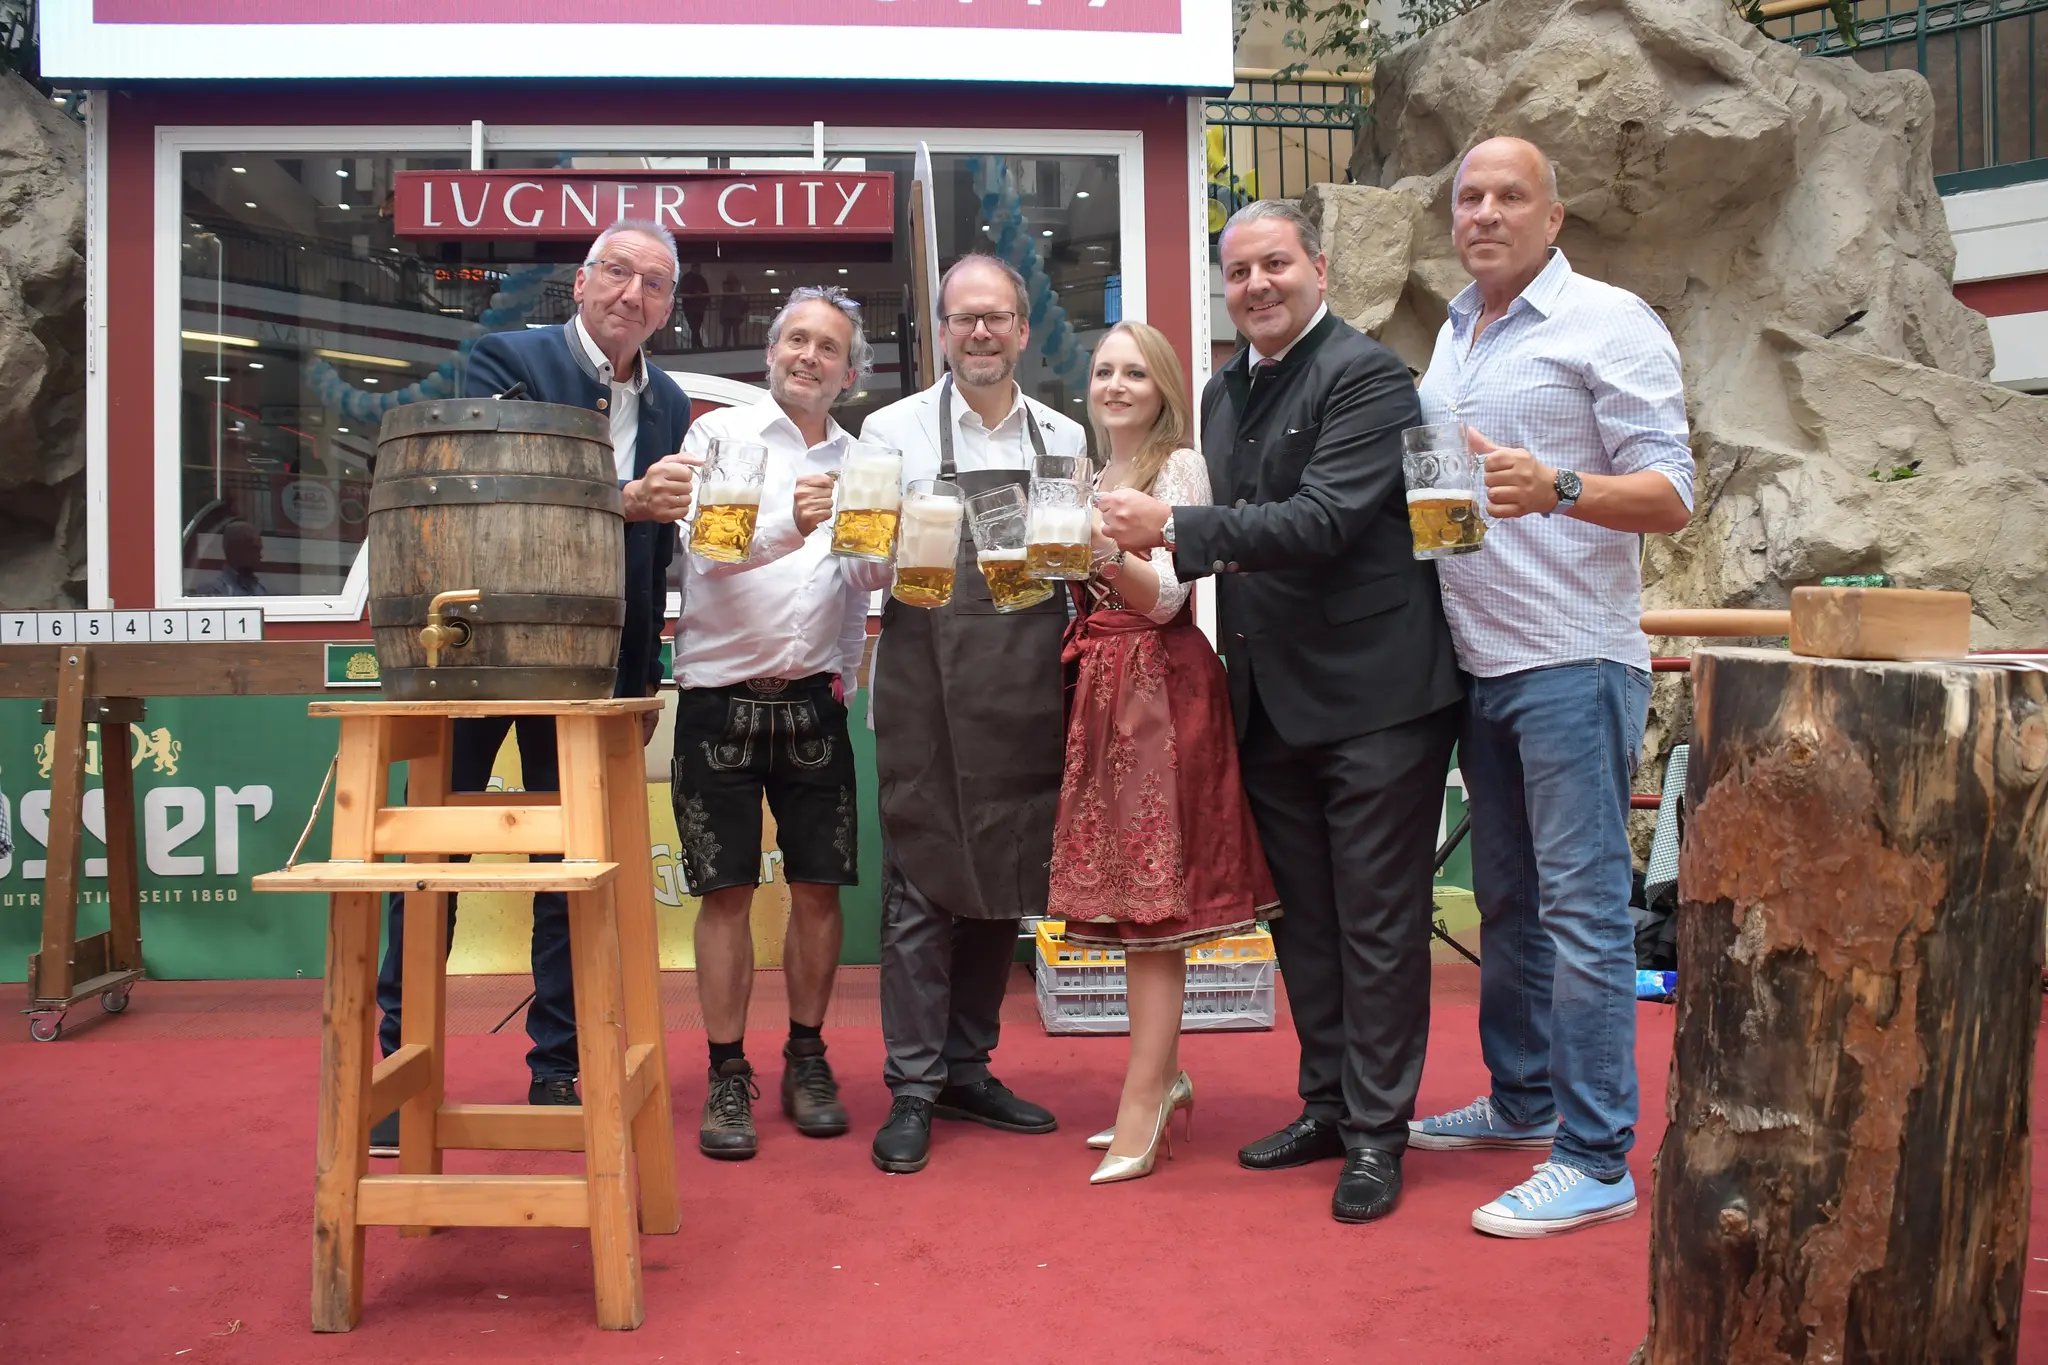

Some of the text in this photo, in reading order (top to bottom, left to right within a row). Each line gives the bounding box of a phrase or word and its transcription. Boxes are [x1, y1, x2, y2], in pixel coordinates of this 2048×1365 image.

[423, 182, 867, 227] LUGNER CITY
[14, 617, 246, 636] 7 6 5 4 3 2 1
[140, 890, 183, 903] SEIT
[192, 889, 238, 902] 1860
